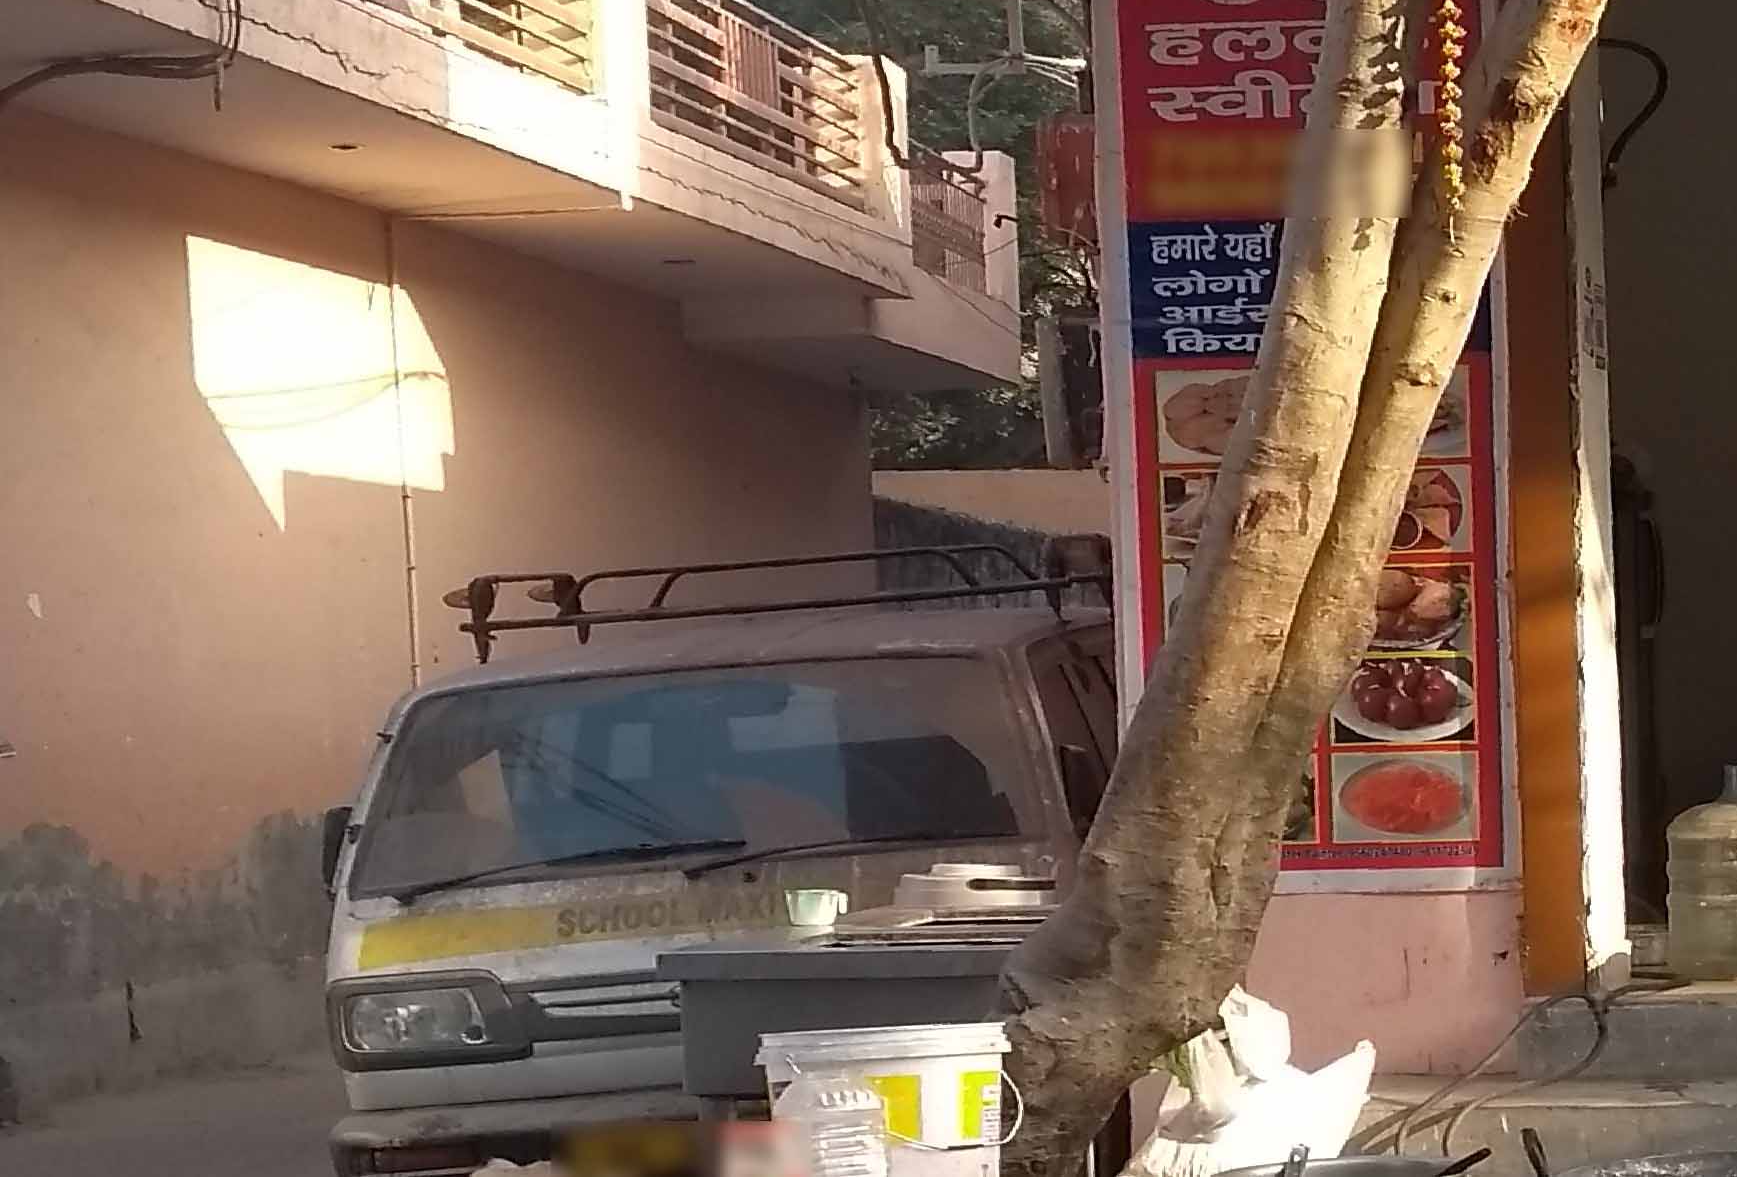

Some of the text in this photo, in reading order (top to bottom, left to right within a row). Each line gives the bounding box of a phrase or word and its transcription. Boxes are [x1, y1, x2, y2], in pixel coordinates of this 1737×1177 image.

[1149, 221, 1276, 265] हमारे यहाँ
[1151, 268, 1272, 297] लोगों
[556, 898, 686, 938] SCHOOL
